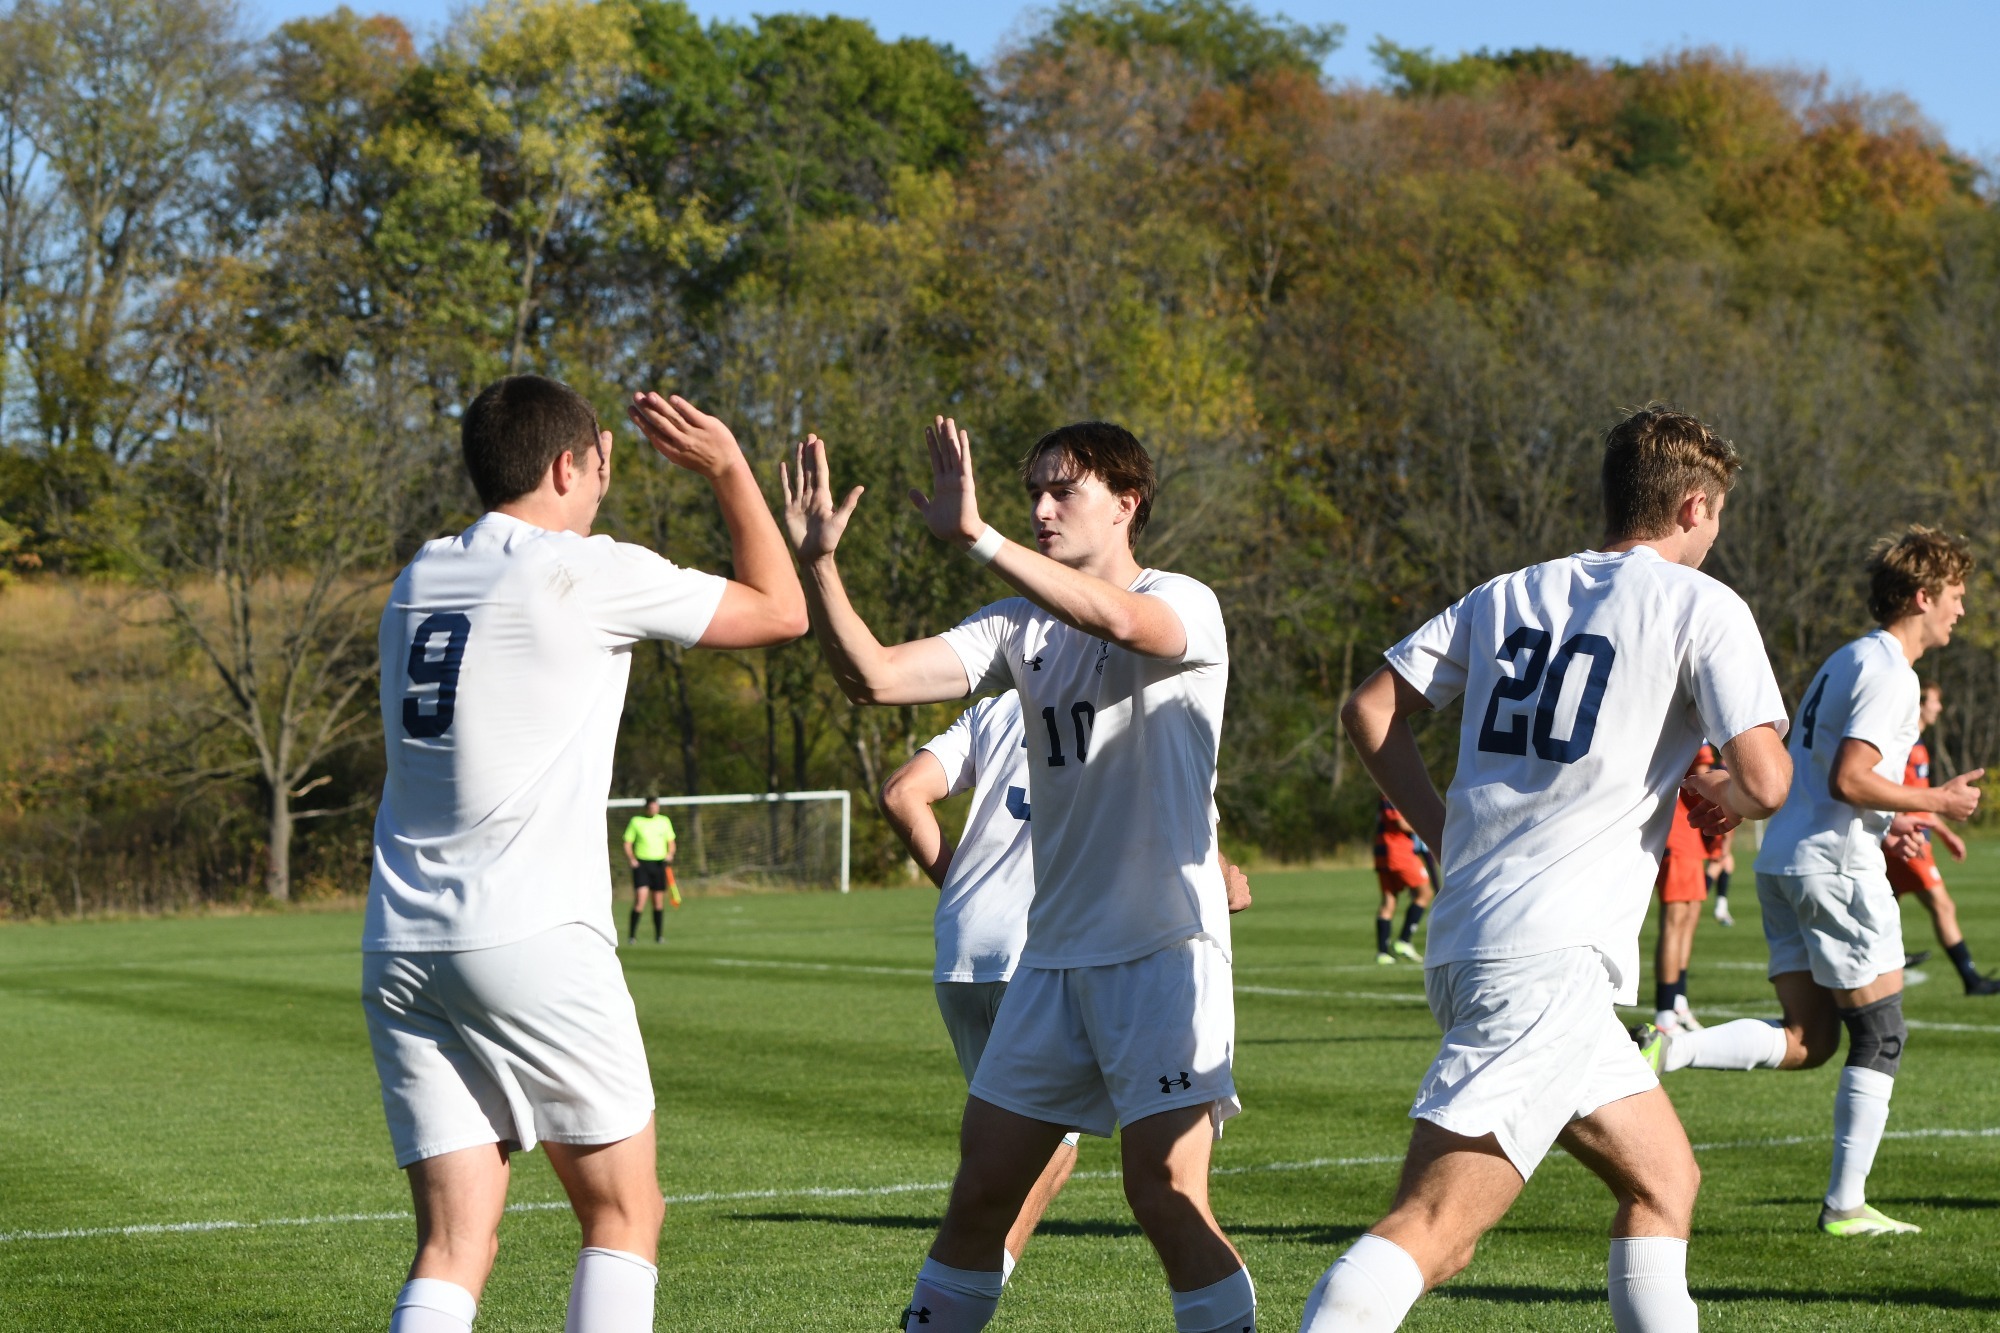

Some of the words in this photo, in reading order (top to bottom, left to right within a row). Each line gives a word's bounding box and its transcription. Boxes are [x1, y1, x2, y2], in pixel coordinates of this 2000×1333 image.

[402, 612, 471, 738] 9
[1478, 626, 1616, 764] 20
[1802, 673, 1829, 749] 4
[1041, 700, 1095, 767] 10
